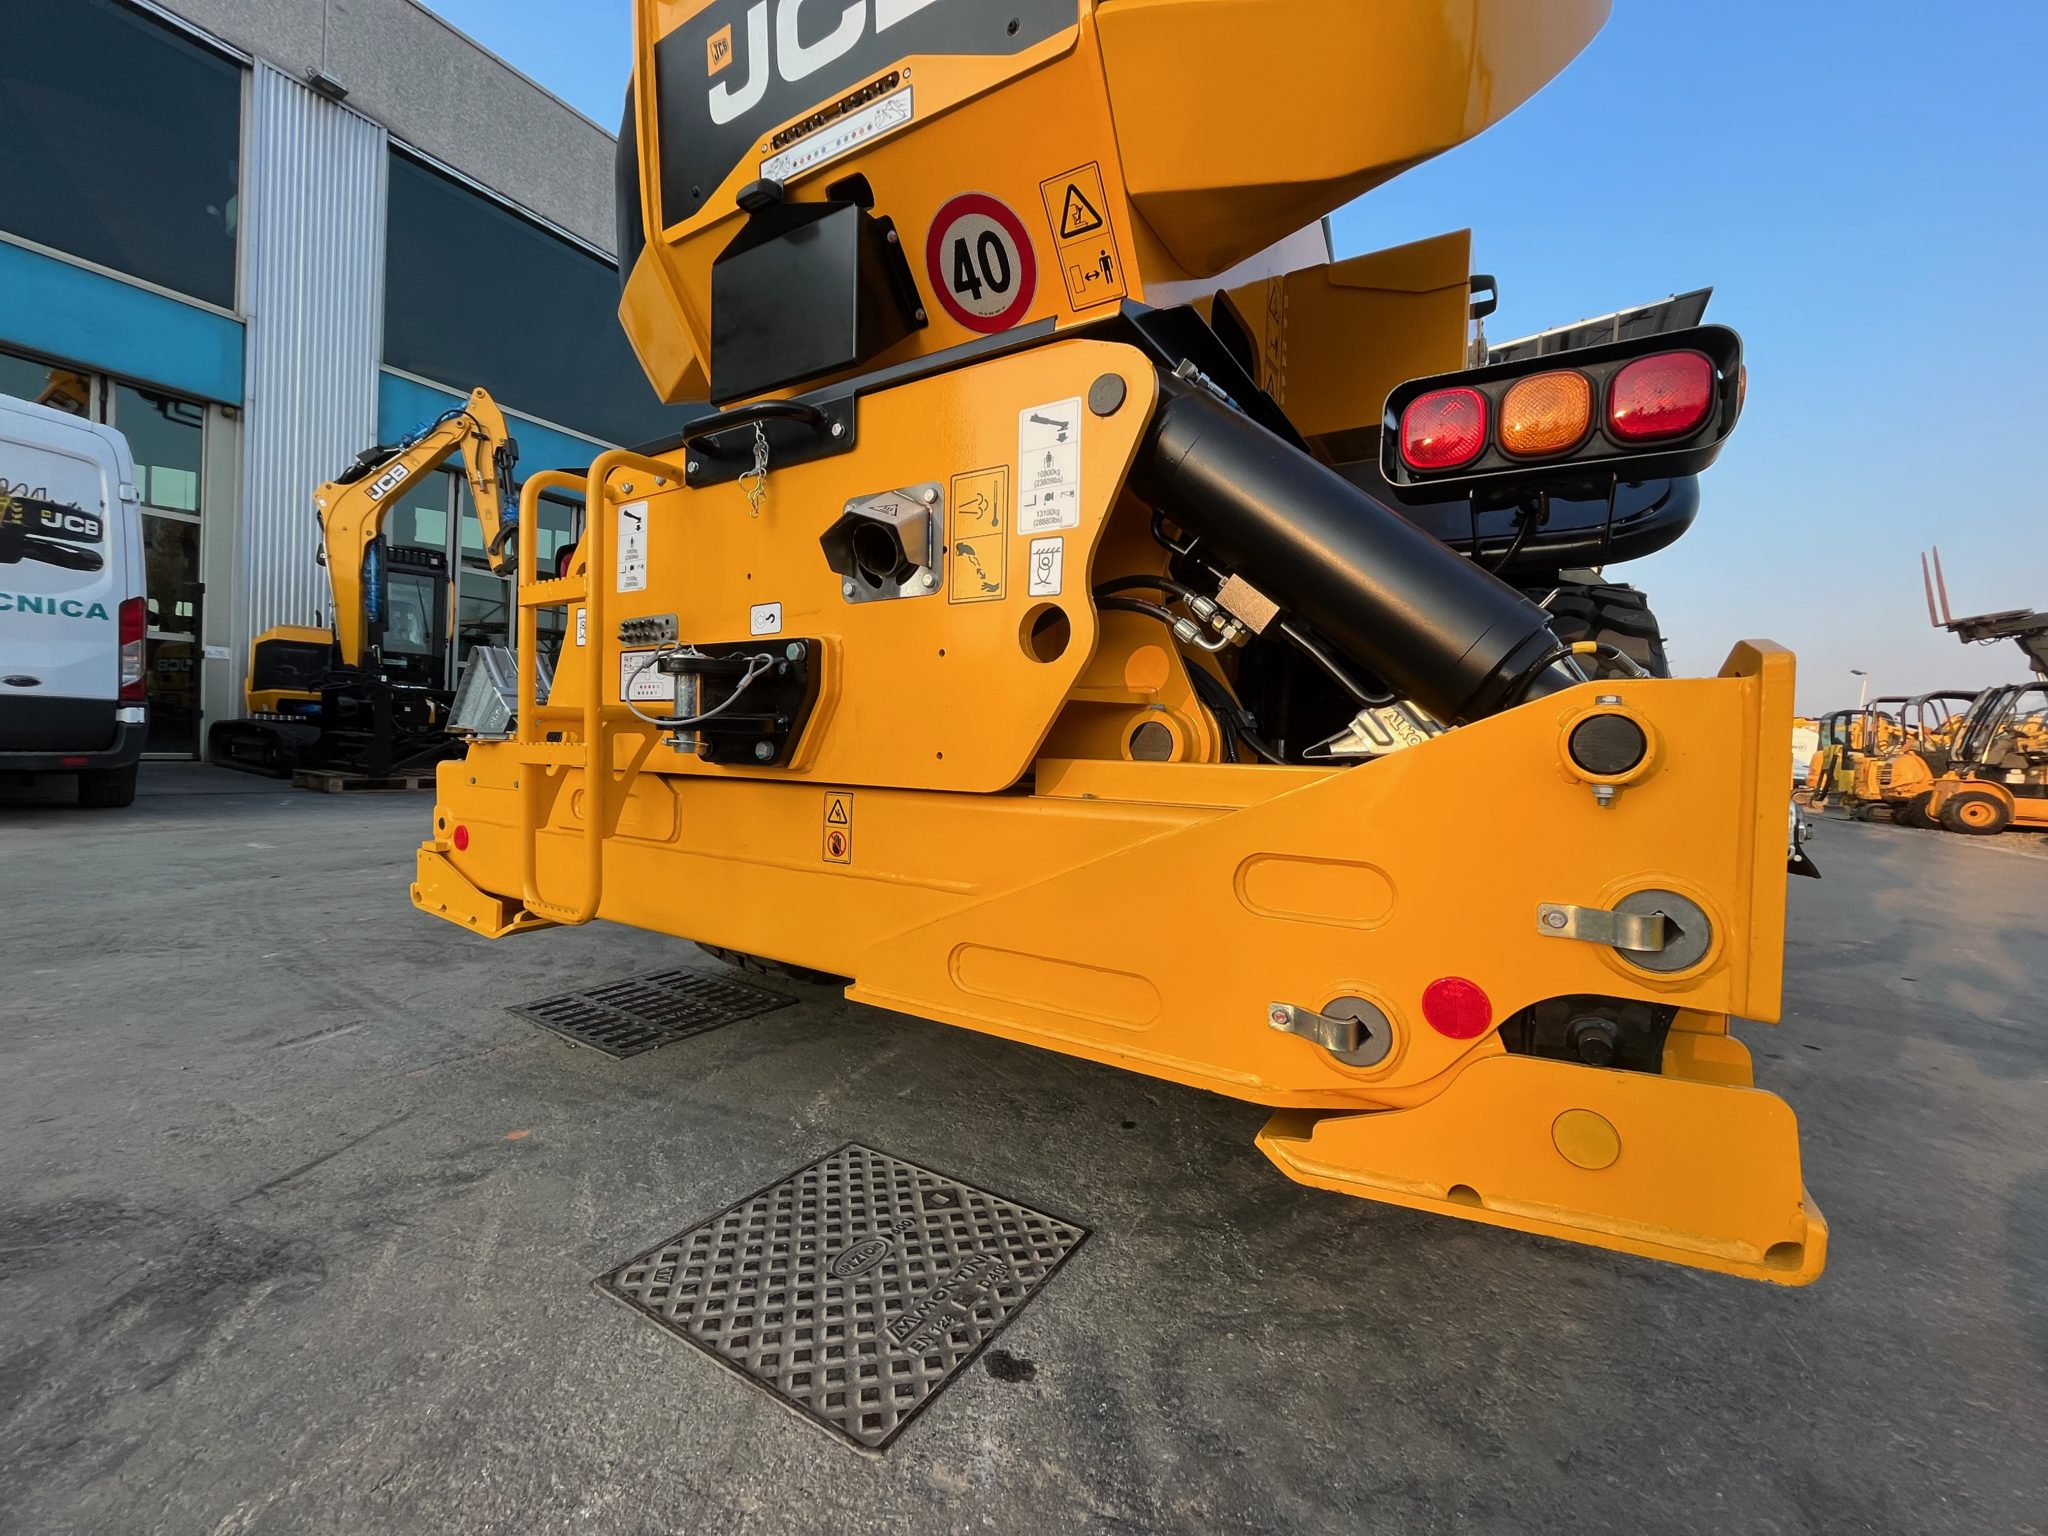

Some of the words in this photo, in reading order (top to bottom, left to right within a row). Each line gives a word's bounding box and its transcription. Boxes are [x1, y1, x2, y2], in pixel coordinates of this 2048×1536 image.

[709, 0, 937, 125] JC
[711, 38, 729, 62] JCB
[954, 230, 1010, 300] 40
[369, 463, 409, 500] JCB
[41, 511, 99, 536] JCB
[914, 1253, 990, 1317] MONTINI
[908, 1333, 935, 1353] EN
[929, 1313, 955, 1334] 124
